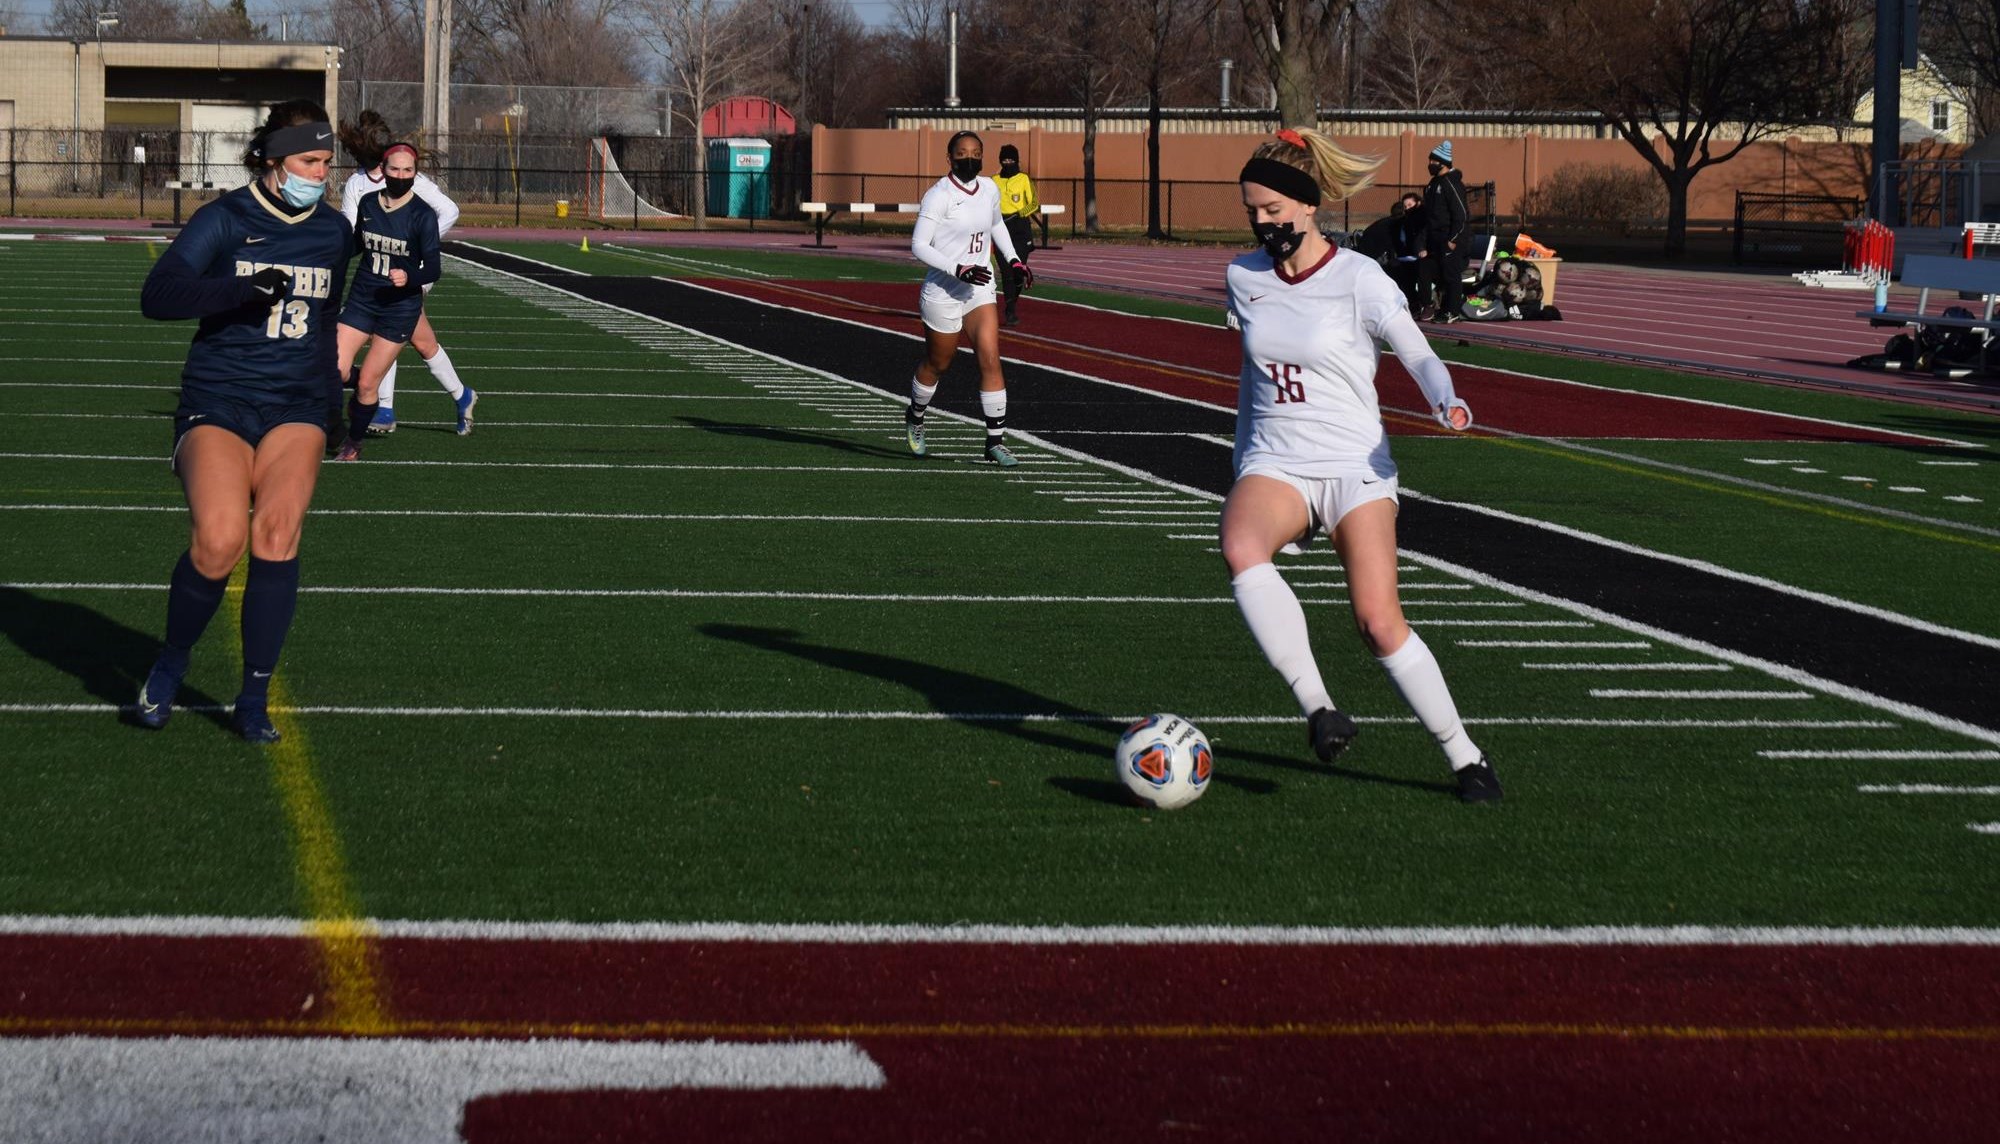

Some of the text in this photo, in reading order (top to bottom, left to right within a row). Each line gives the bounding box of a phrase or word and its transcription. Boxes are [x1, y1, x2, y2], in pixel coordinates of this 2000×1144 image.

[362, 231, 410, 257] ETHEL
[967, 231, 984, 254] 15
[371, 252, 390, 276] 11
[266, 299, 310, 339] 13
[1265, 363, 1306, 404] 16
